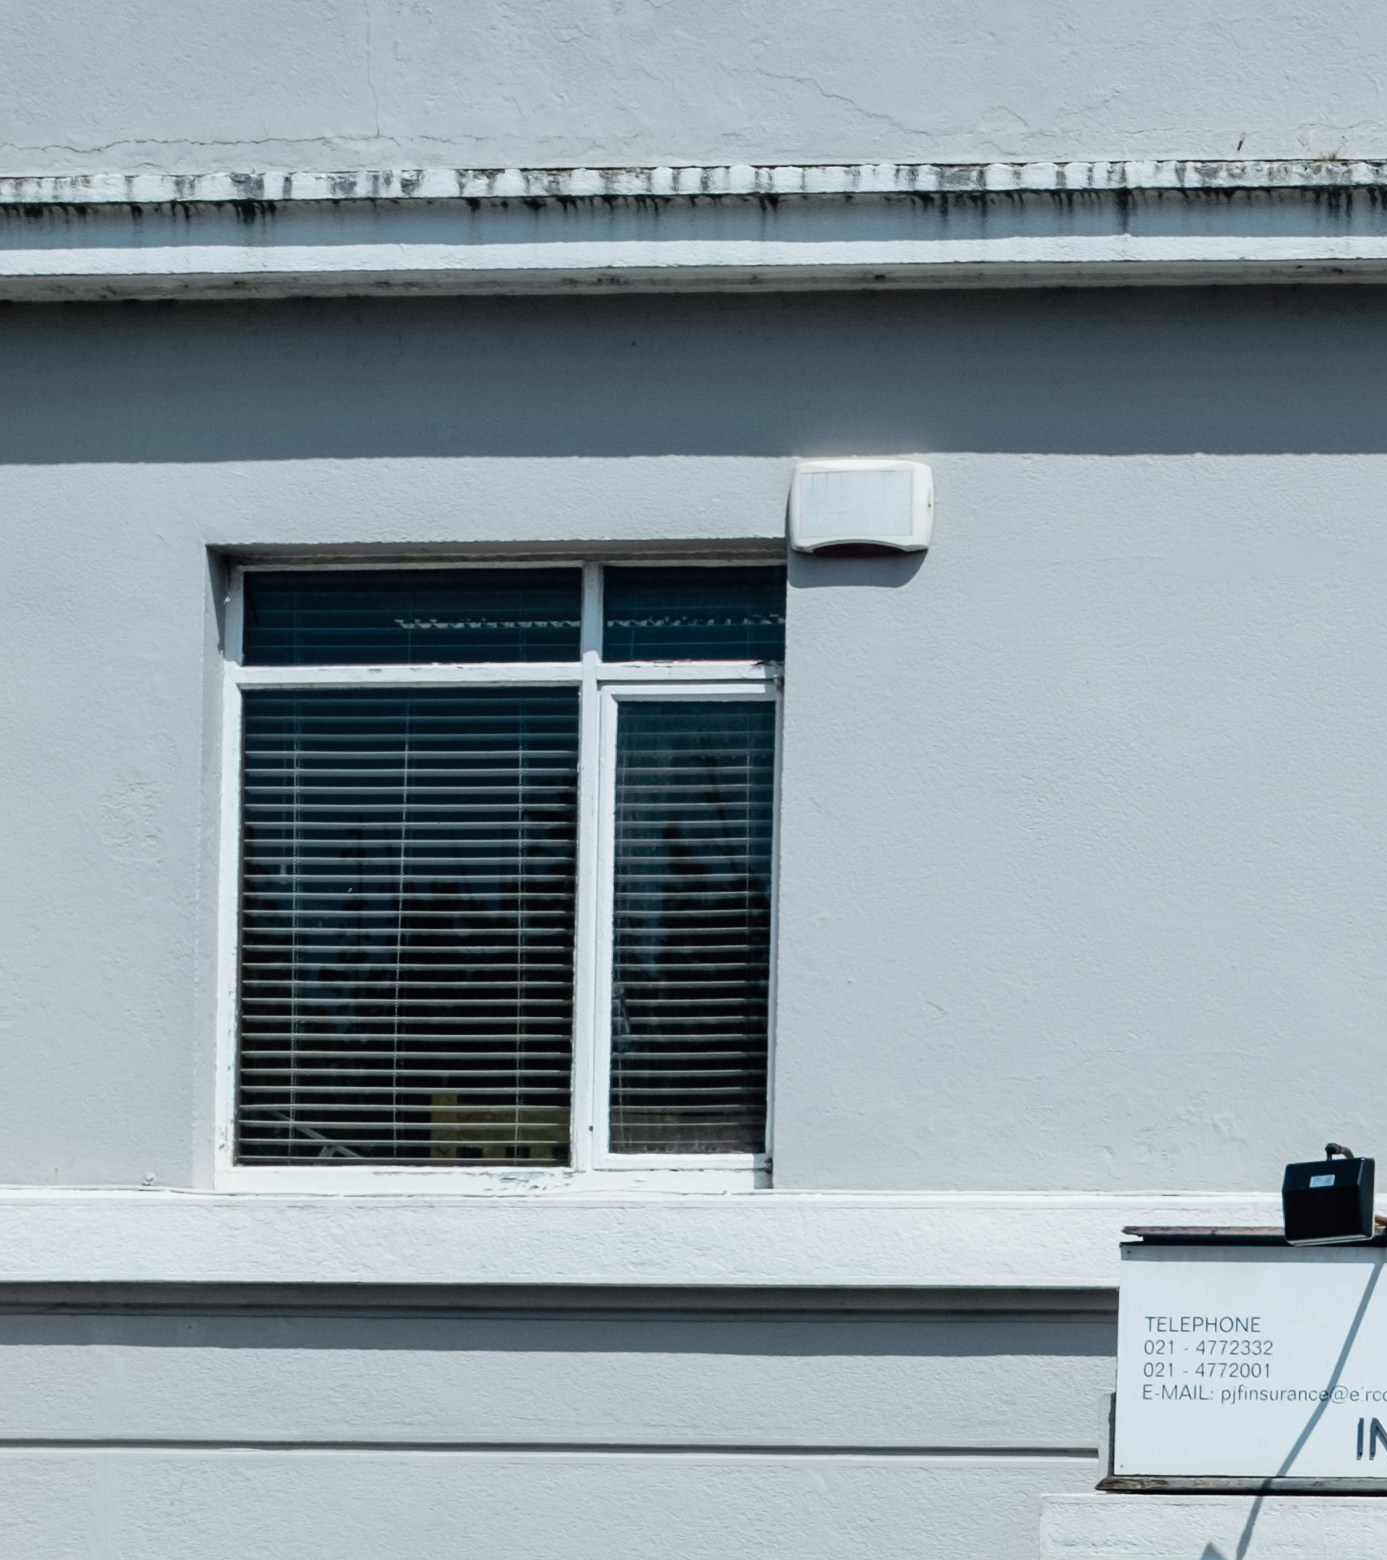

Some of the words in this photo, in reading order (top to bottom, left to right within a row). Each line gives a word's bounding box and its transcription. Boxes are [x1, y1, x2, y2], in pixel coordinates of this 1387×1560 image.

[1144, 1316, 1262, 1333] TELEPHONE
[1144, 1339, 1174, 1356] 021
[1195, 1339, 1274, 1356] 4772332
[1143, 1362, 1174, 1378] 021
[1195, 1362, 1270, 1379] 4772001
[1142, 1384, 1215, 1401] E-MAIL:
